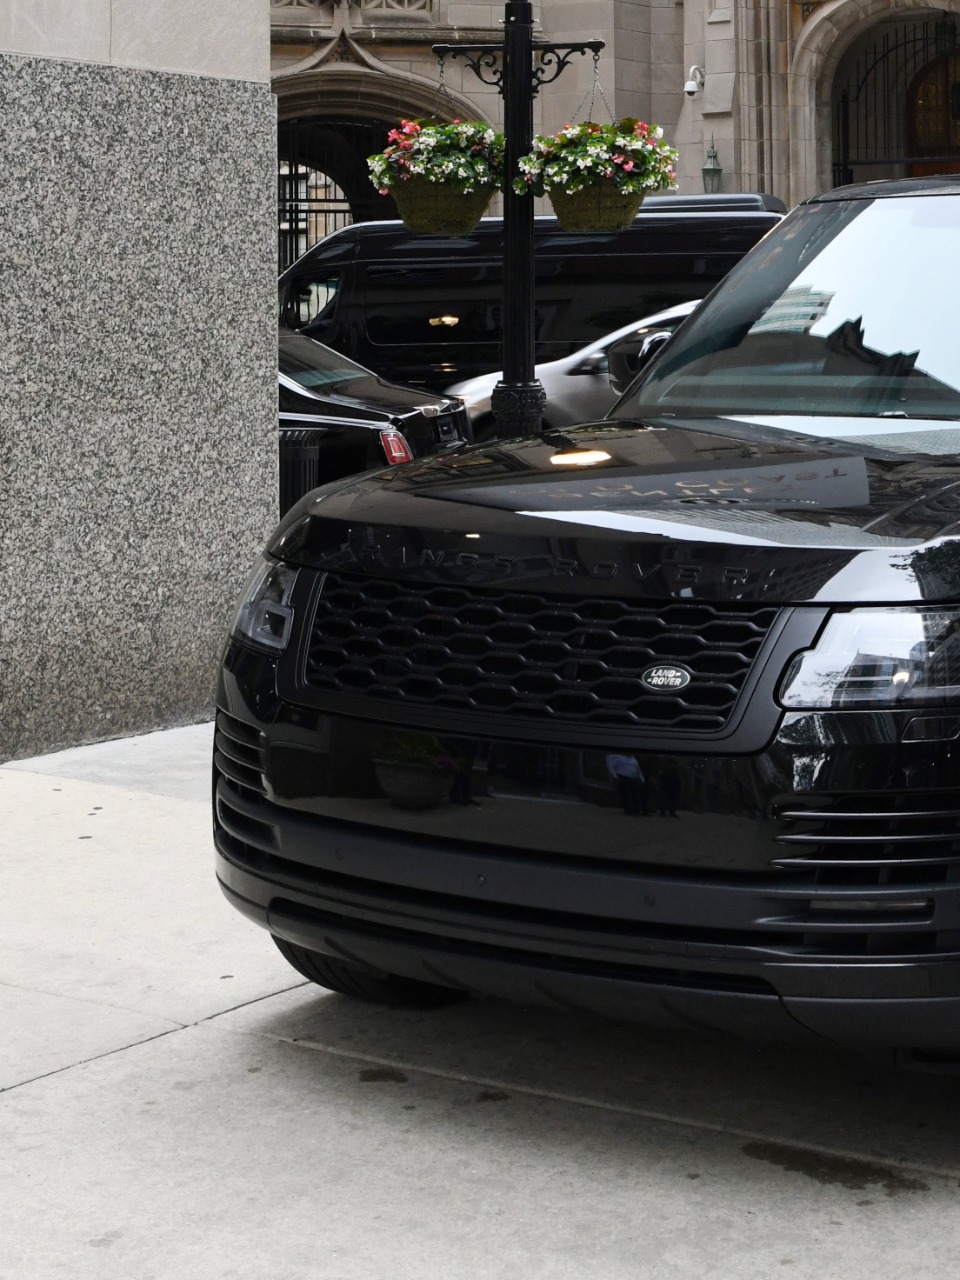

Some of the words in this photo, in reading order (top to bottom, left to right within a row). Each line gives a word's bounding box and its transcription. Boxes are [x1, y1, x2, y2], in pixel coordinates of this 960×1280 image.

[552, 559, 749, 585] ROVER
[651, 669, 676, 677] LAND
[651, 677, 682, 686] ROVER
